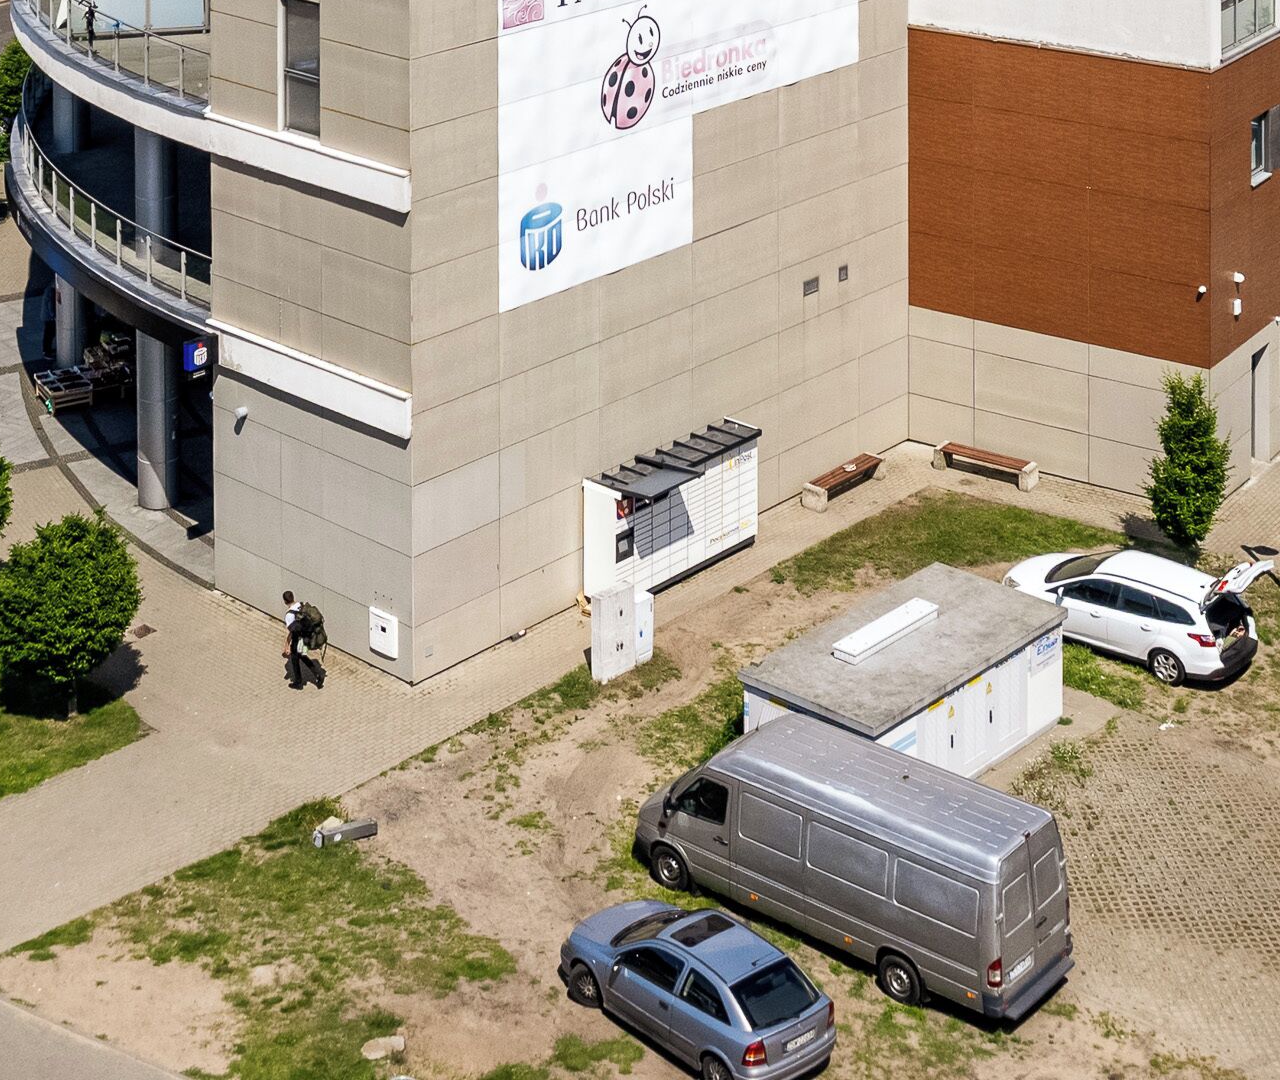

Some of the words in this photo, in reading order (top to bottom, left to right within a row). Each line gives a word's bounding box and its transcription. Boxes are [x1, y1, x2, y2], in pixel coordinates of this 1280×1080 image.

[662, 74, 714, 99] Codziennie
[717, 65, 744, 86] niskie
[746, 60, 767, 81] ceny
[576, 196, 620, 231] Bank
[626, 178, 674, 215] Polski
